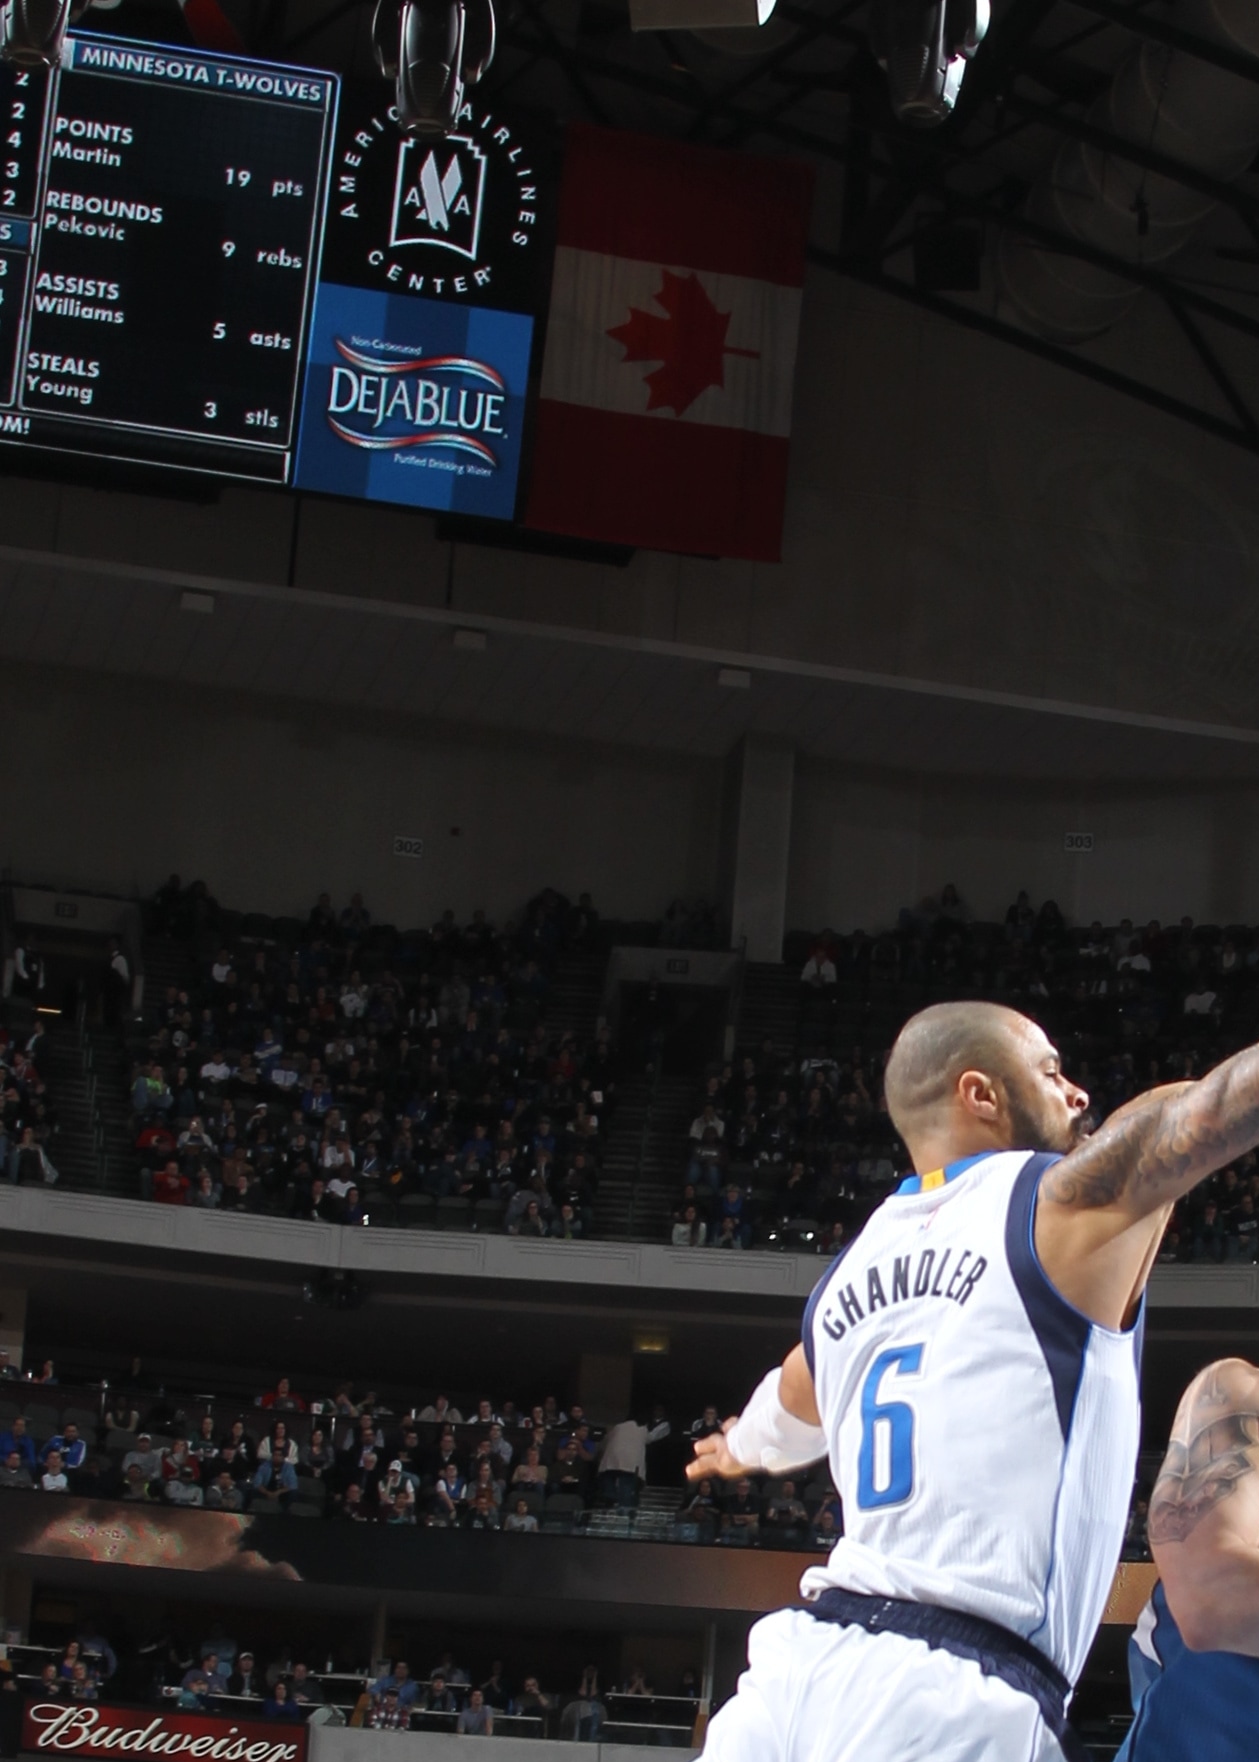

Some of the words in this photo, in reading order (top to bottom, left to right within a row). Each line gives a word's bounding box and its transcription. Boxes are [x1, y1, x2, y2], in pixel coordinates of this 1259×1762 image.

[82, 47, 209, 83] MINNESOTA
[216, 70, 322, 101] T-WOLVES
[12, 103, 25, 119] 2
[7, 132, 22, 148] 4
[55, 117, 133, 144] POINTS
[52, 141, 121, 166] Martin
[6, 162, 19, 178] 3
[225, 168, 251, 187] 19
[272, 180, 303, 197] pts
[458, 103, 536, 246] AIRLINES
[3, 190, 16, 206] 2
[46, 190, 163, 223] REBOUNDS
[45, 213, 125, 241] Pekovic
[221, 241, 236, 257] 9
[257, 248, 302, 268] rebs
[368, 250, 491, 293] CENTER
[36, 272, 119, 300] ASSISTS
[35, 295, 124, 323] Williams
[213, 323, 226, 339] 5
[250, 331, 291, 349] asts
[27, 352, 100, 378] STEALS
[26, 375, 93, 404] Young
[204, 402, 217, 418] 3
[245, 409, 279, 428] stls
[395, 839, 422, 855] 302
[1066, 835, 1092, 849] 303
[822, 1249, 988, 1341] CHANDLER
[857, 1342, 926, 1511] 6
